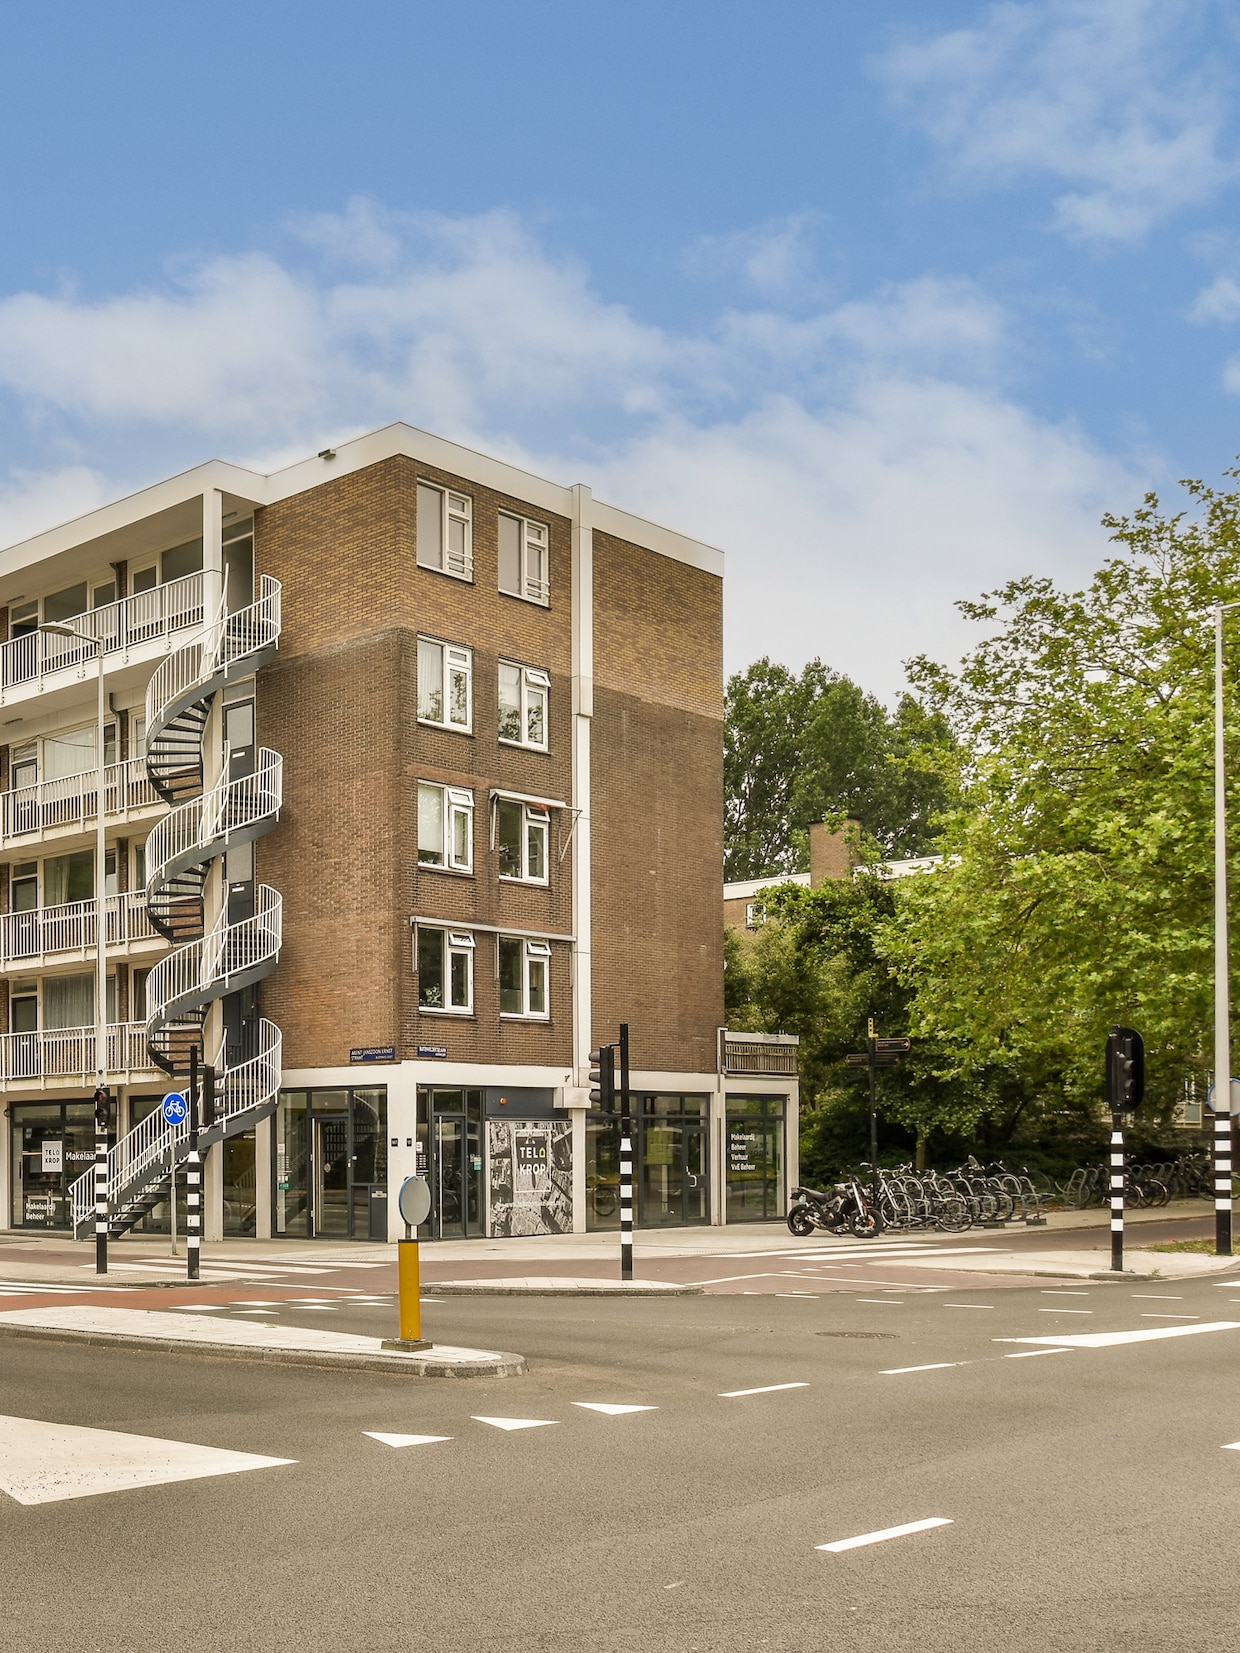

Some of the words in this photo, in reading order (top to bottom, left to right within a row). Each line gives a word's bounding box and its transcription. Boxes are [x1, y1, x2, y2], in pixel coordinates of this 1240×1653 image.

[731, 1133, 755, 1141] Makelaardij
[731, 1143, 747, 1151] Beheer
[520, 1164, 546, 1175] KROP
[731, 1163, 740, 1171] VvE
[741, 1163, 756, 1171] Beheer
[26, 1202, 56, 1212] Makelaardij
[25, 1212, 45, 1220] Beheer
